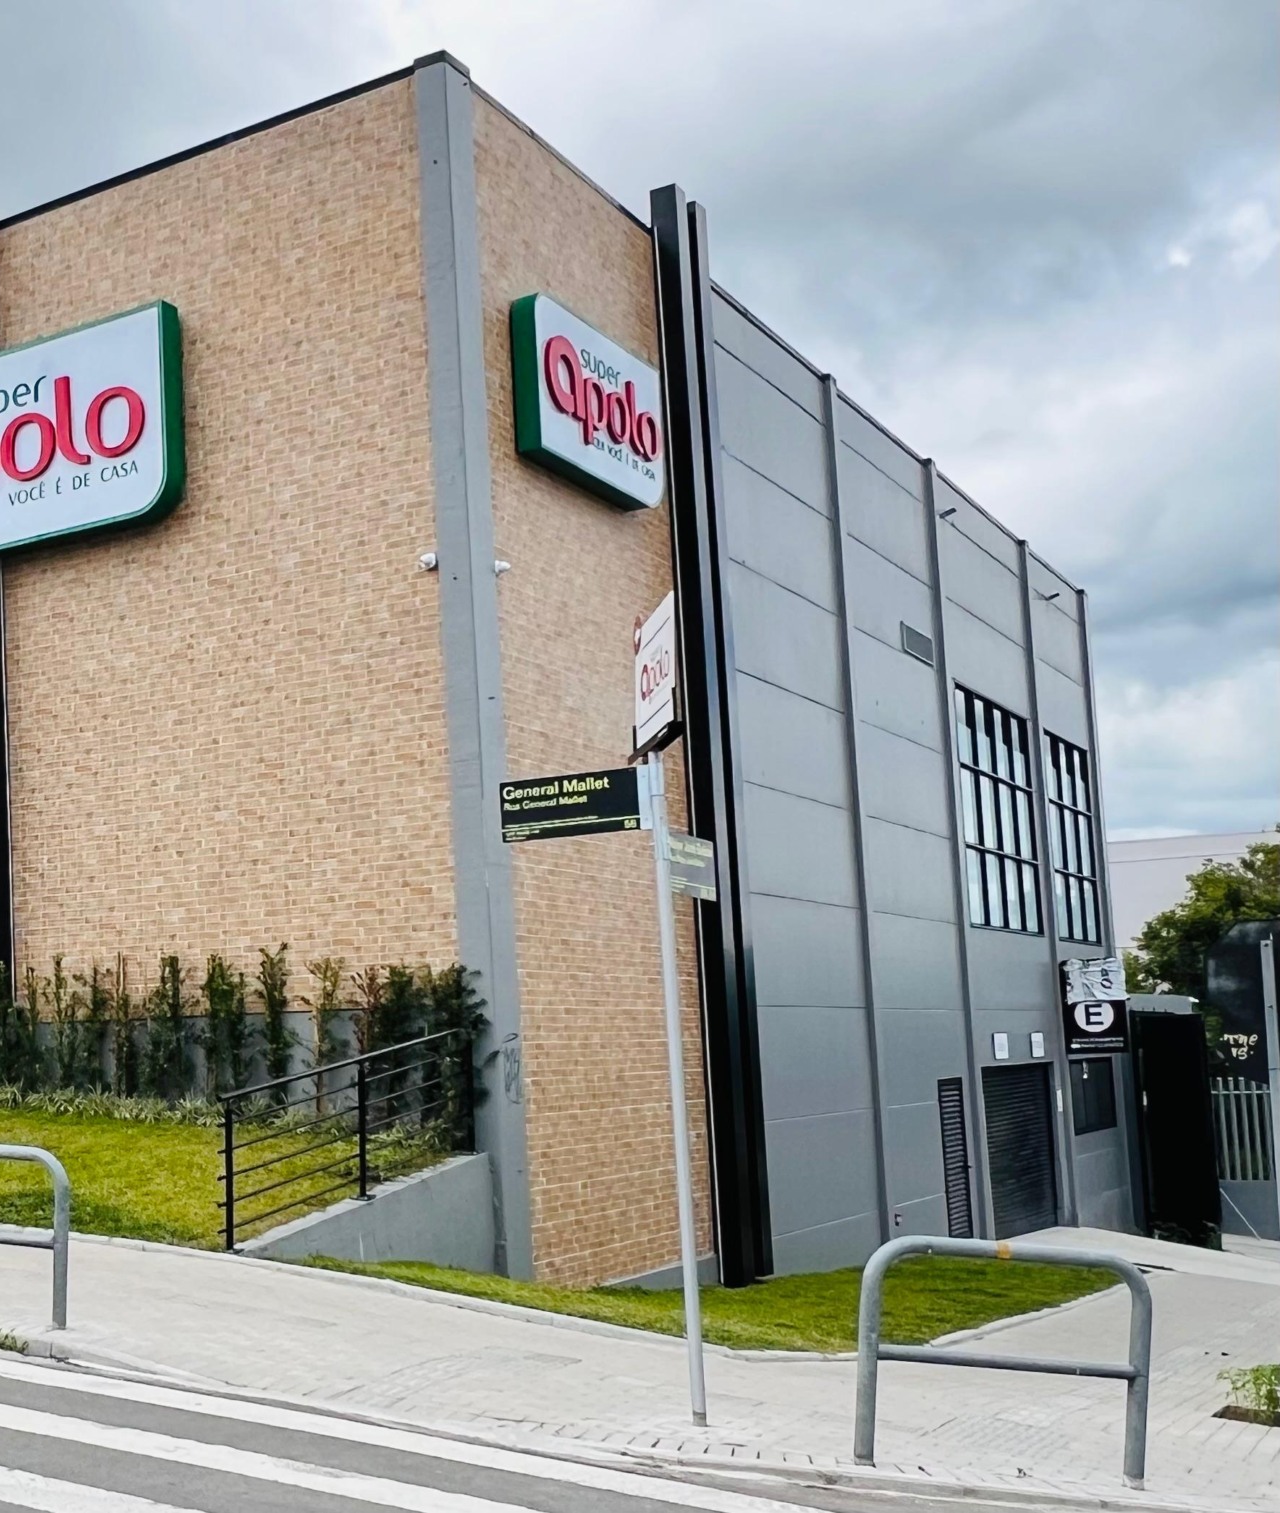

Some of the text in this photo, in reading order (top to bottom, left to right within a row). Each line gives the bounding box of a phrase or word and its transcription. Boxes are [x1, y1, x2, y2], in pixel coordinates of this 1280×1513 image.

[581, 349, 621, 388] super
[543, 335, 661, 463] apolo
[8, 481, 46, 506] VOCÊ
[56, 476, 62, 494] É
[73, 472, 91, 490] DE
[100, 460, 139, 482] CASA
[502, 776, 610, 800] General Mallet
[522, 798, 557, 810] General
[559, 795, 588, 805] Mallet
[1084, 1004, 1104, 1026] E
